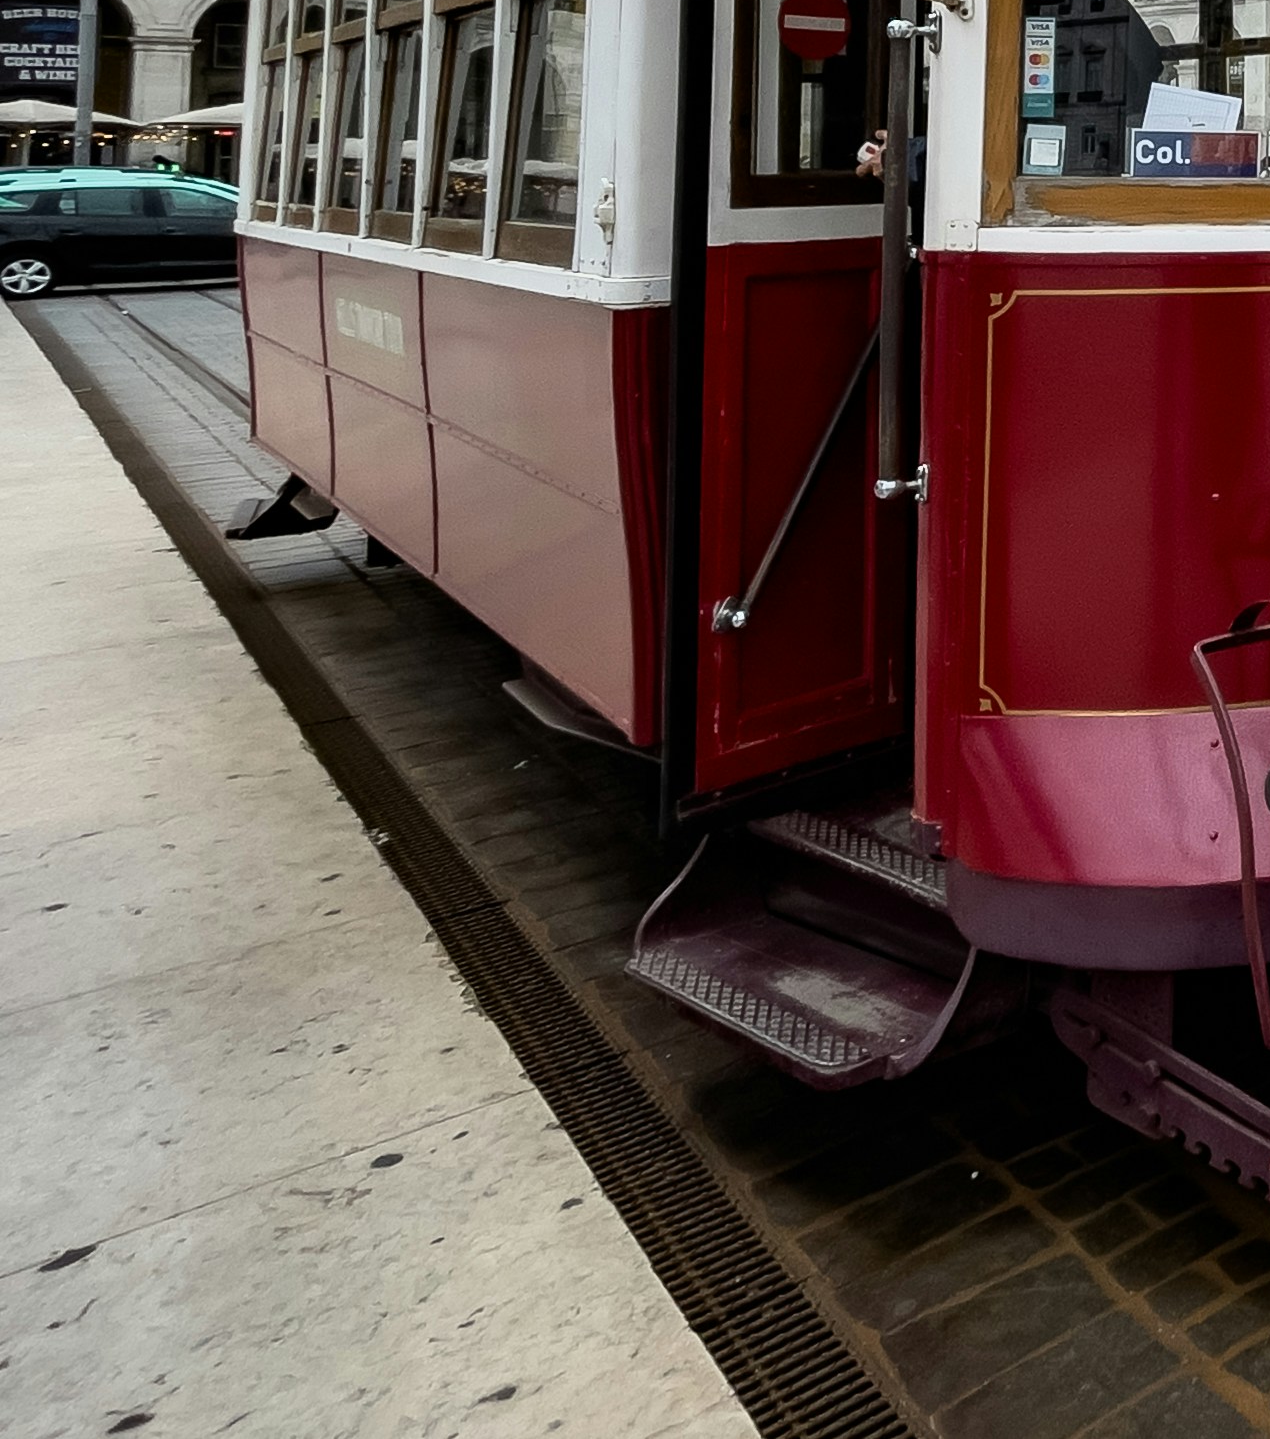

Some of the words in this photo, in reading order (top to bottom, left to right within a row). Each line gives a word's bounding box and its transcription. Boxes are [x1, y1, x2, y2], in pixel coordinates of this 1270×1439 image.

[46, 9, 80, 20] HOU
[1030, 23, 1050, 31] VISA
[1030, 39, 1050, 47] VISA
[4, 57, 80, 67] COCKTAIL
[19, 70, 31, 80] &
[1135, 139, 1191, 165] Col.
